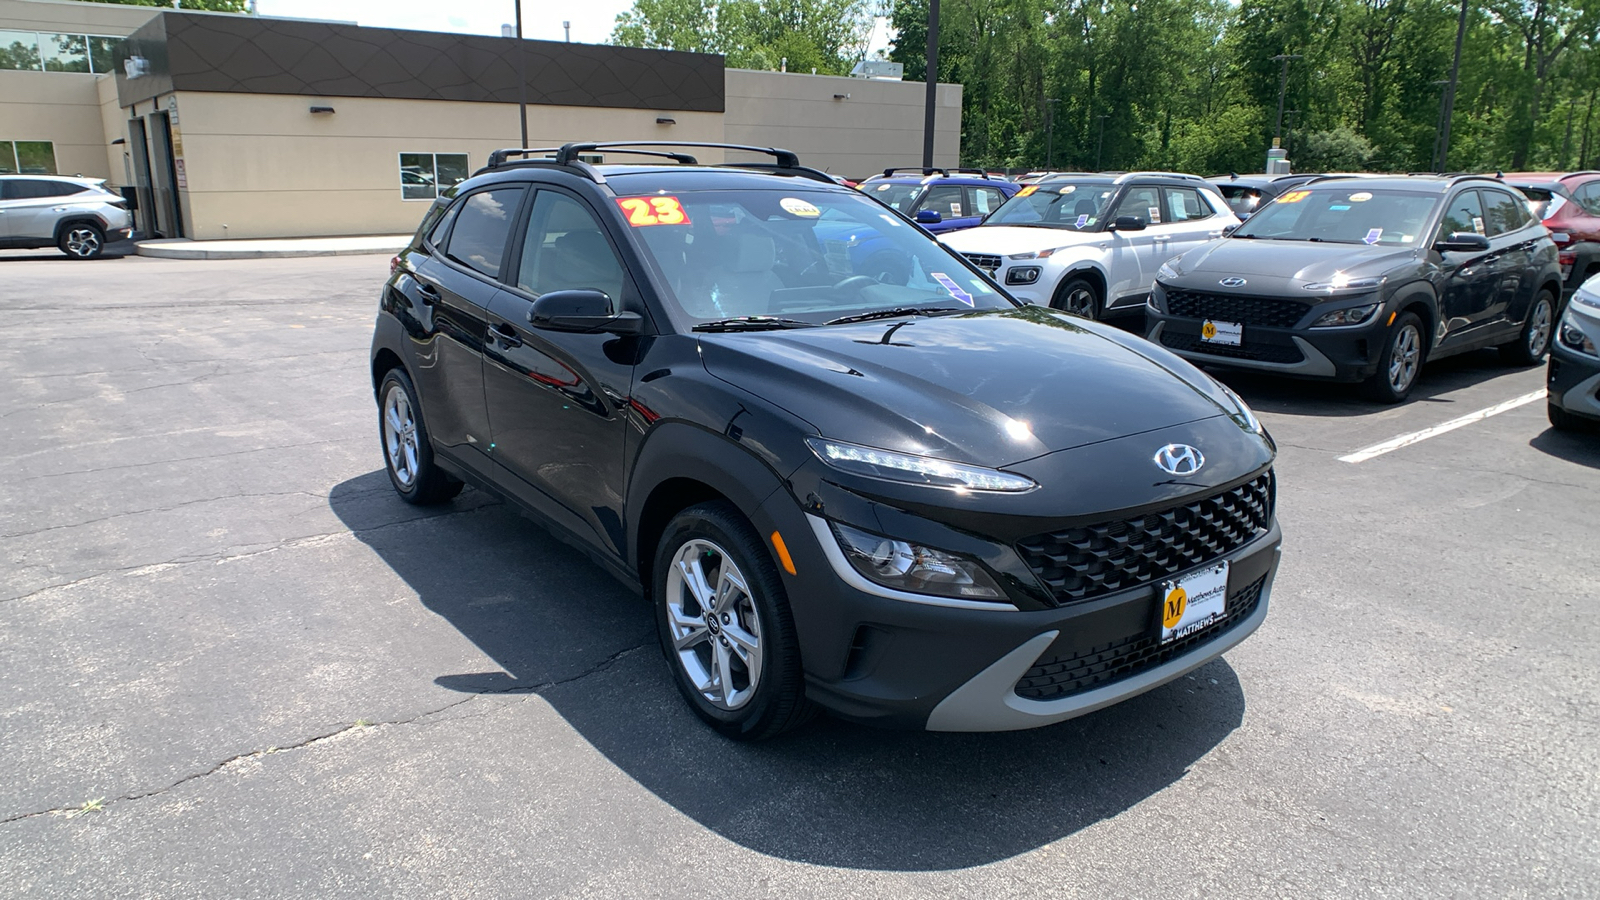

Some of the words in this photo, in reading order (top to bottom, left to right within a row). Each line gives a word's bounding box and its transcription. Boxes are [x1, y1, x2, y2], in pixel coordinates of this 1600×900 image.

[620, 196, 684, 225] 23
[1205, 326, 1215, 335] M
[1211, 585, 1226, 595] Auto
[1165, 596, 1184, 622] M
[1175, 614, 1214, 640] MATTHEWS
